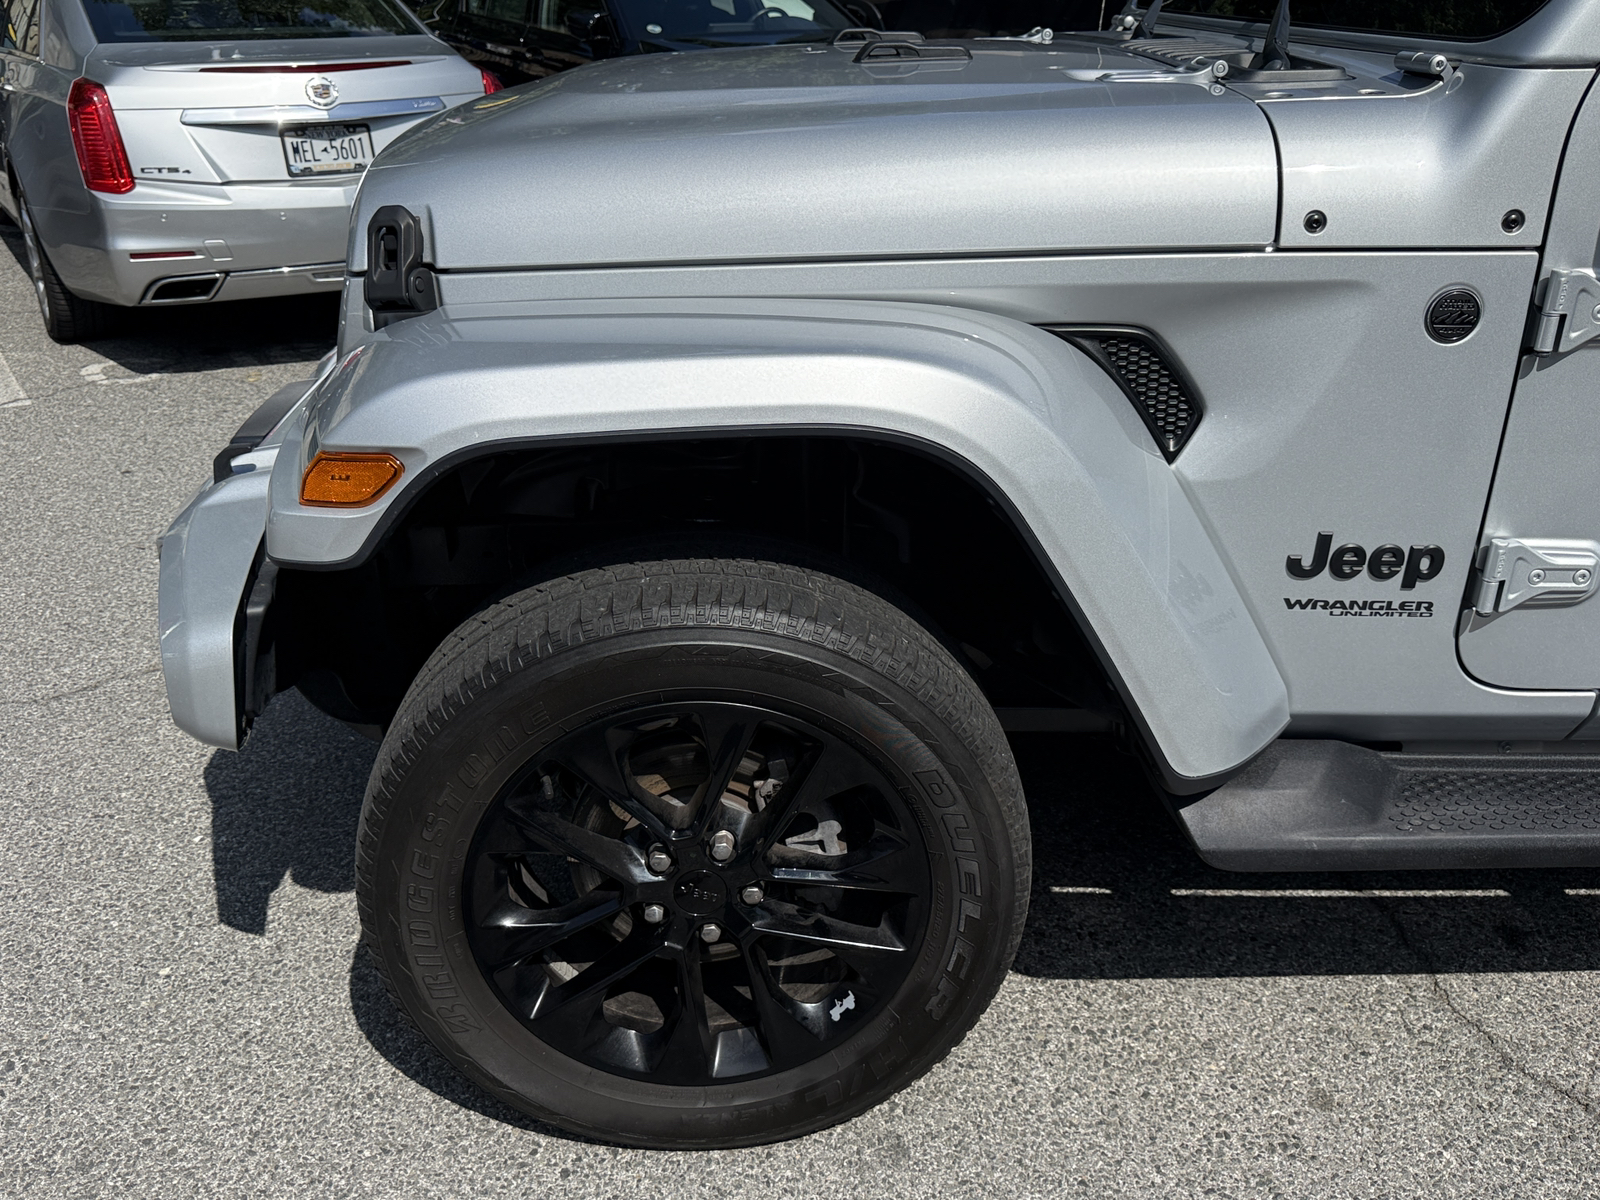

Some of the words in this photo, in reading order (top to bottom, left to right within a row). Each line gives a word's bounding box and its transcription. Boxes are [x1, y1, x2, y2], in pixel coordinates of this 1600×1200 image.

[291, 139, 321, 163] MEL
[329, 137, 366, 160] 5601
[304, 130, 324, 139] NEW
[325, 128, 349, 138] YORK
[1285, 531, 1445, 591] Jeep
[1283, 598, 1434, 612] WRANGLER
[406, 701, 551, 1035] BRIDGESTONE
[912, 769, 982, 1022] DUELER
